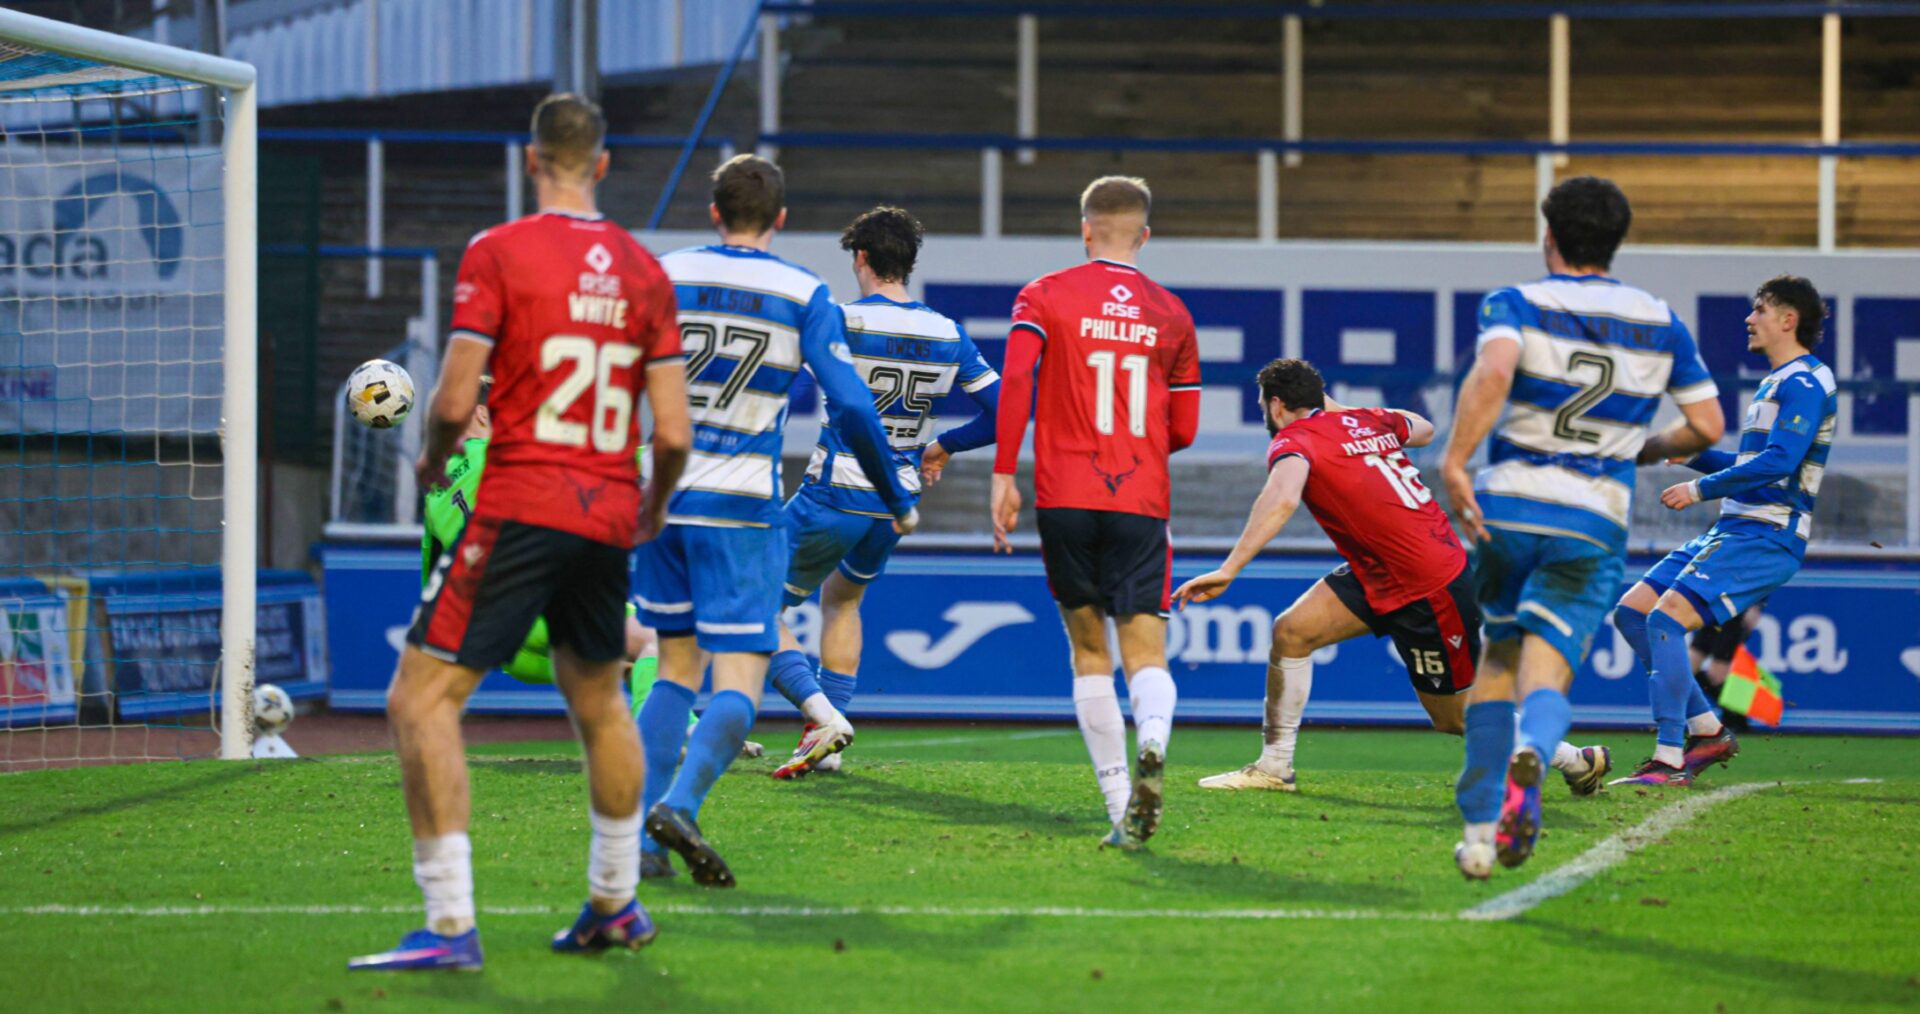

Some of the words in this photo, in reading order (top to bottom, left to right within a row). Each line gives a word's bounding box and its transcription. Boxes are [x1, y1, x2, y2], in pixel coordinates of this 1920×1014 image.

[568, 292, 628, 329] WHITE
[697, 284, 763, 313] WILSON
[1102, 301, 1140, 319] RSE
[886, 337, 931, 358] OWENS
[1080, 317, 1158, 347] PHILLIPS
[680, 322, 771, 411] 27
[534, 335, 642, 453] 26
[868, 366, 942, 438] 25
[1087, 350, 1150, 438] 11
[1553, 351, 1616, 443] 2
[1364, 450, 1432, 510] 16
[1410, 648, 1444, 675] 16
